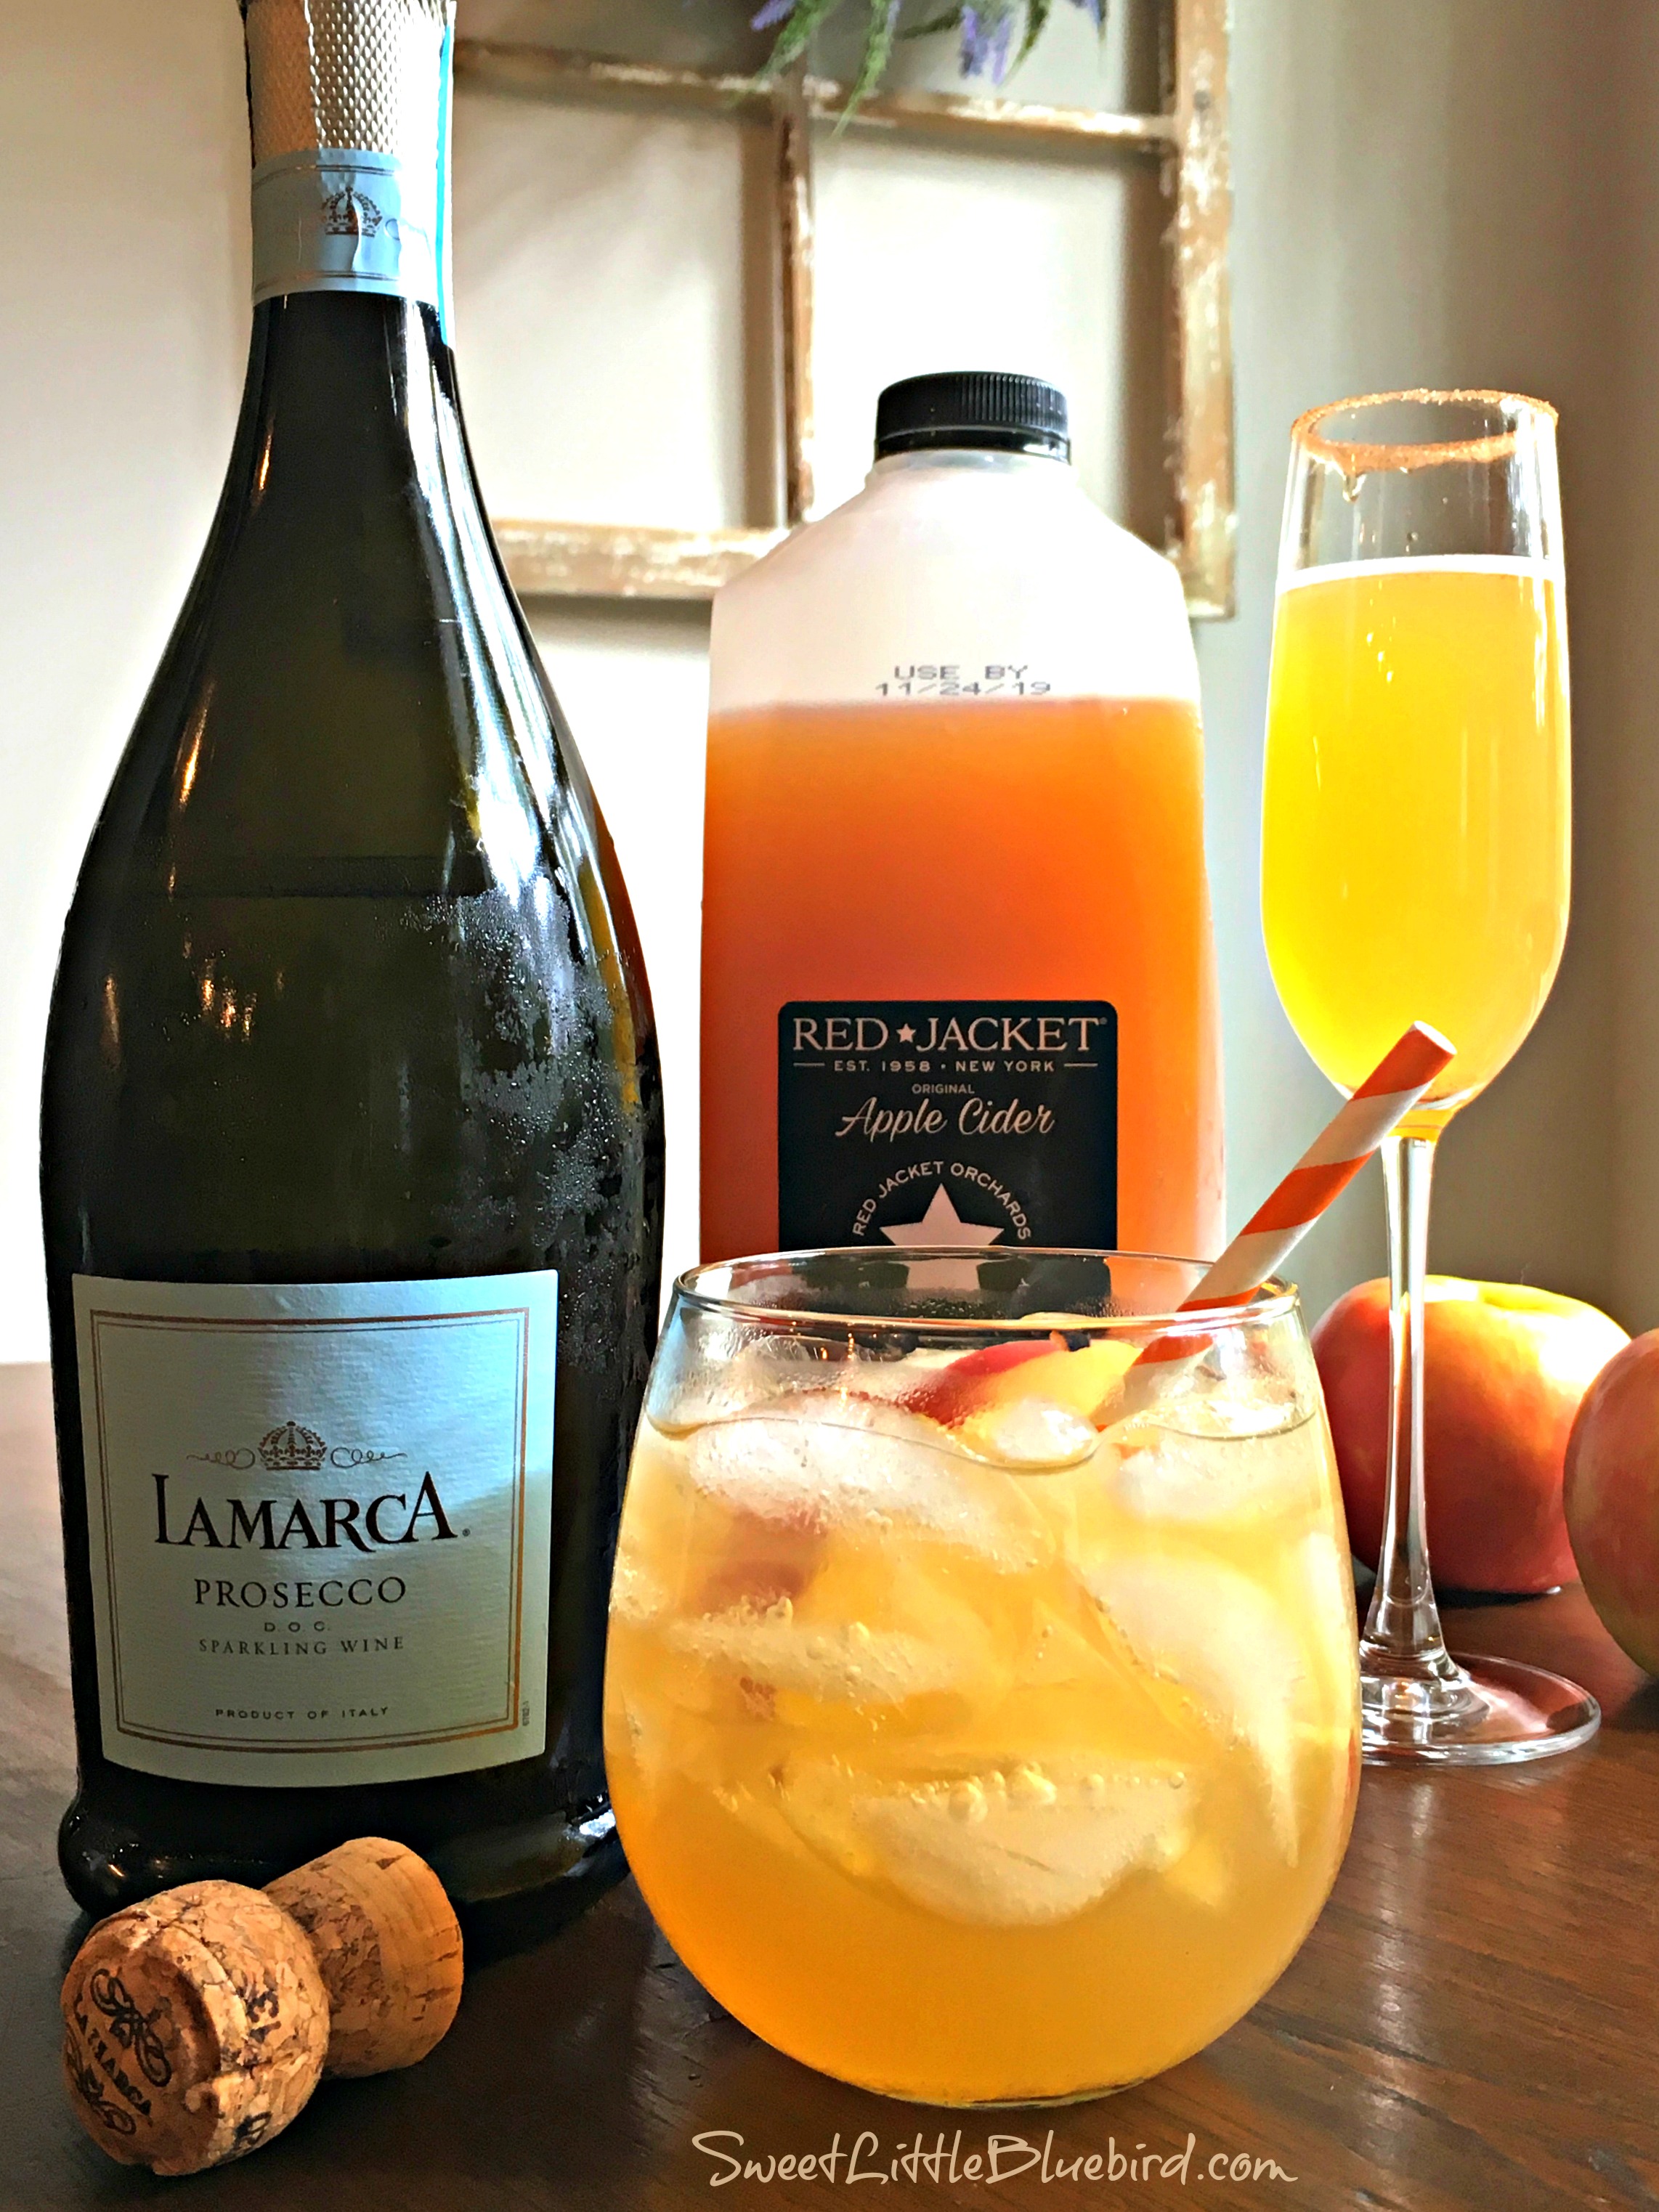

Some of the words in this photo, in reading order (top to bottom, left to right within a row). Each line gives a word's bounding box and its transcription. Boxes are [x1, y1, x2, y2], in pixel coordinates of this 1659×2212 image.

[894, 664, 960, 680] USE
[984, 664, 1029, 680] BY
[875, 681, 1051, 696] 11/24/19
[792, 1017, 889, 1052] RED
[834, 1060, 870, 1072] EST.
[881, 1060, 930, 1073] 1958
[955, 1060, 996, 1072] NEW
[1004, 1060, 1055, 1072] YORK
[912, 1083, 975, 1094] ORIGINAL
[835, 1097, 948, 1143] Apple
[958, 1097, 1055, 1136] Cider
[852, 1199, 877, 1236] RED
[879, 1161, 944, 1198] JACKET
[950, 1163, 1031, 1240] ORCHARDS
[194, 1577, 406, 1609] PROSECCO
[199, 1639, 328, 1656] SPARKLING
[341, 1636, 405, 1654] WINE
[215, 1708, 295, 1720] PRODUCT
[307, 1710, 327, 1720] OF
[342, 1707, 389, 1718] ITALY
